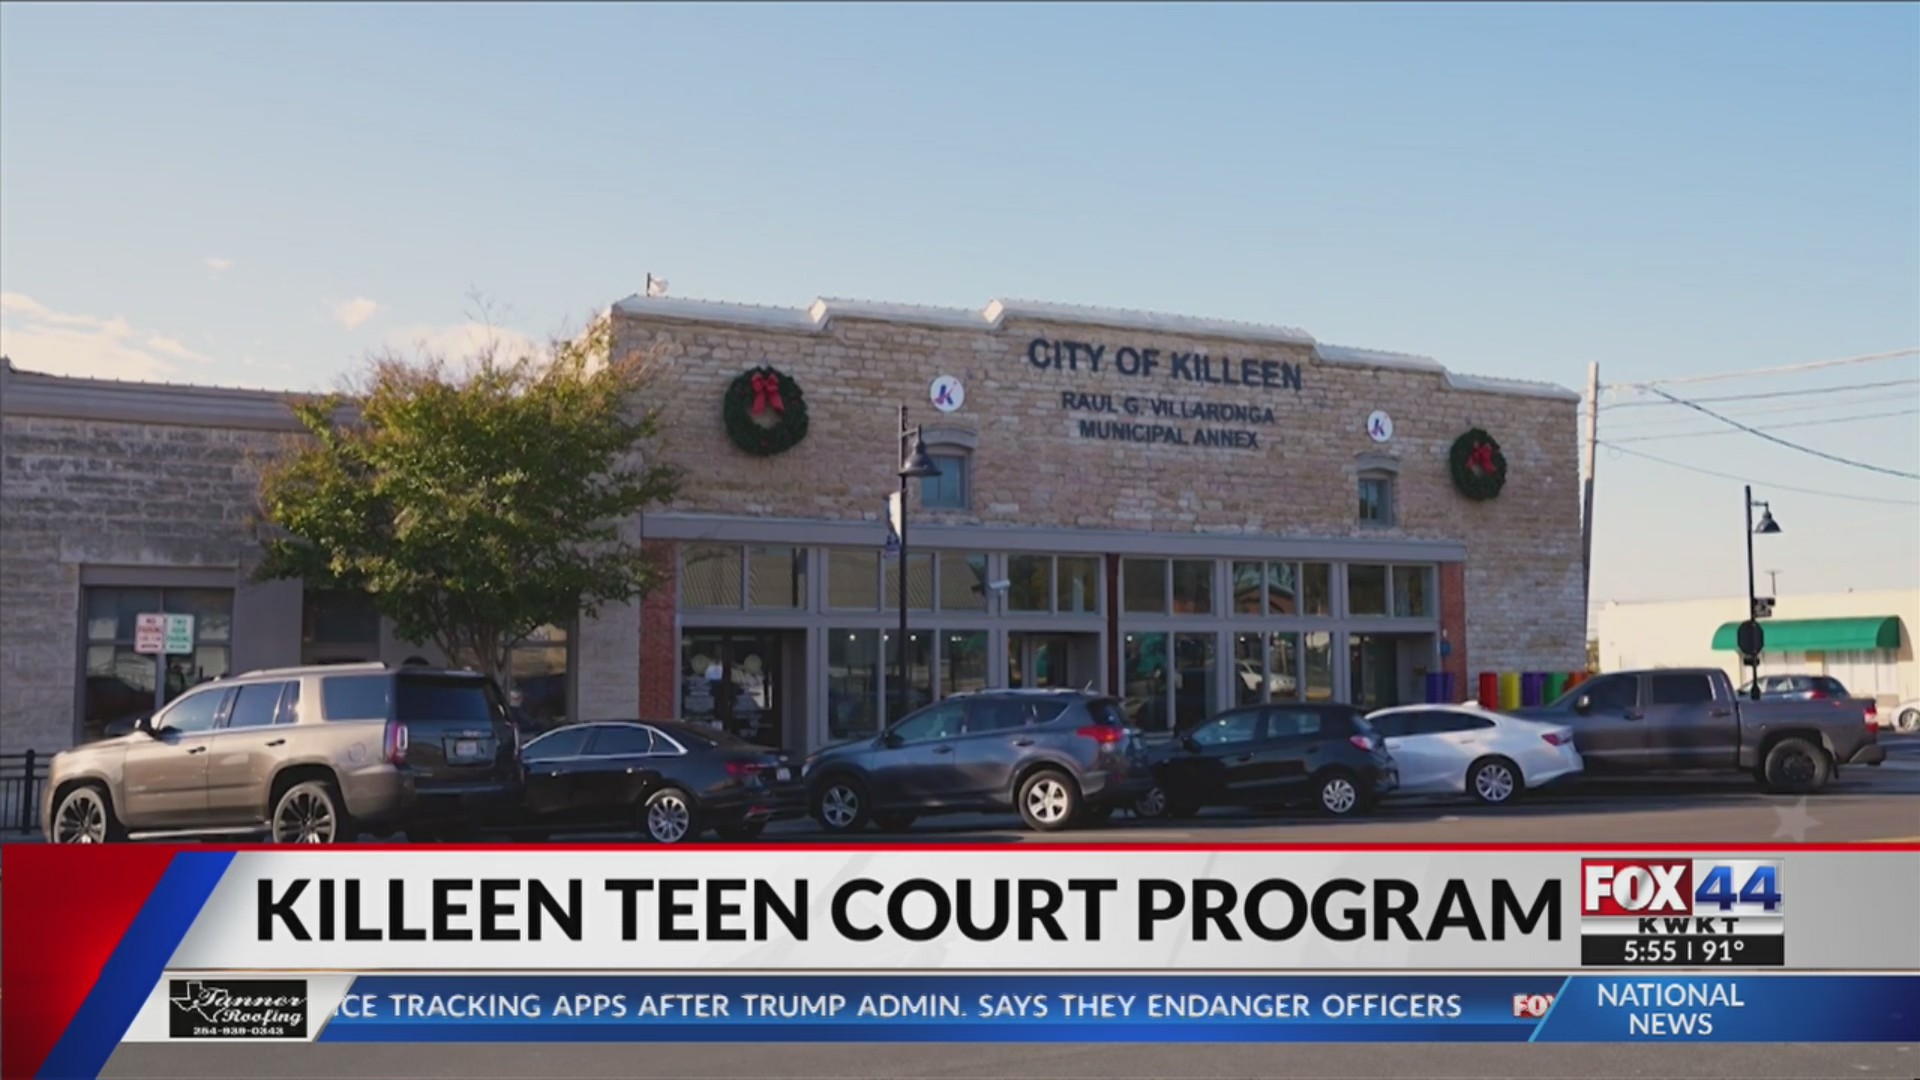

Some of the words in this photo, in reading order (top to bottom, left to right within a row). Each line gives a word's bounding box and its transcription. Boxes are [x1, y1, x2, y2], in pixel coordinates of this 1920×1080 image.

[1028, 338, 1105, 372] CITY
[1116, 346, 1159, 377] OF
[1171, 351, 1302, 391] KILLEEN
[1062, 391, 1118, 413] RAUL
[1123, 397, 1144, 416] G.
[1150, 400, 1275, 424] VILLARONGA
[1079, 419, 1189, 445] MUNICIPAL
[1193, 428, 1259, 449] ANNEX
